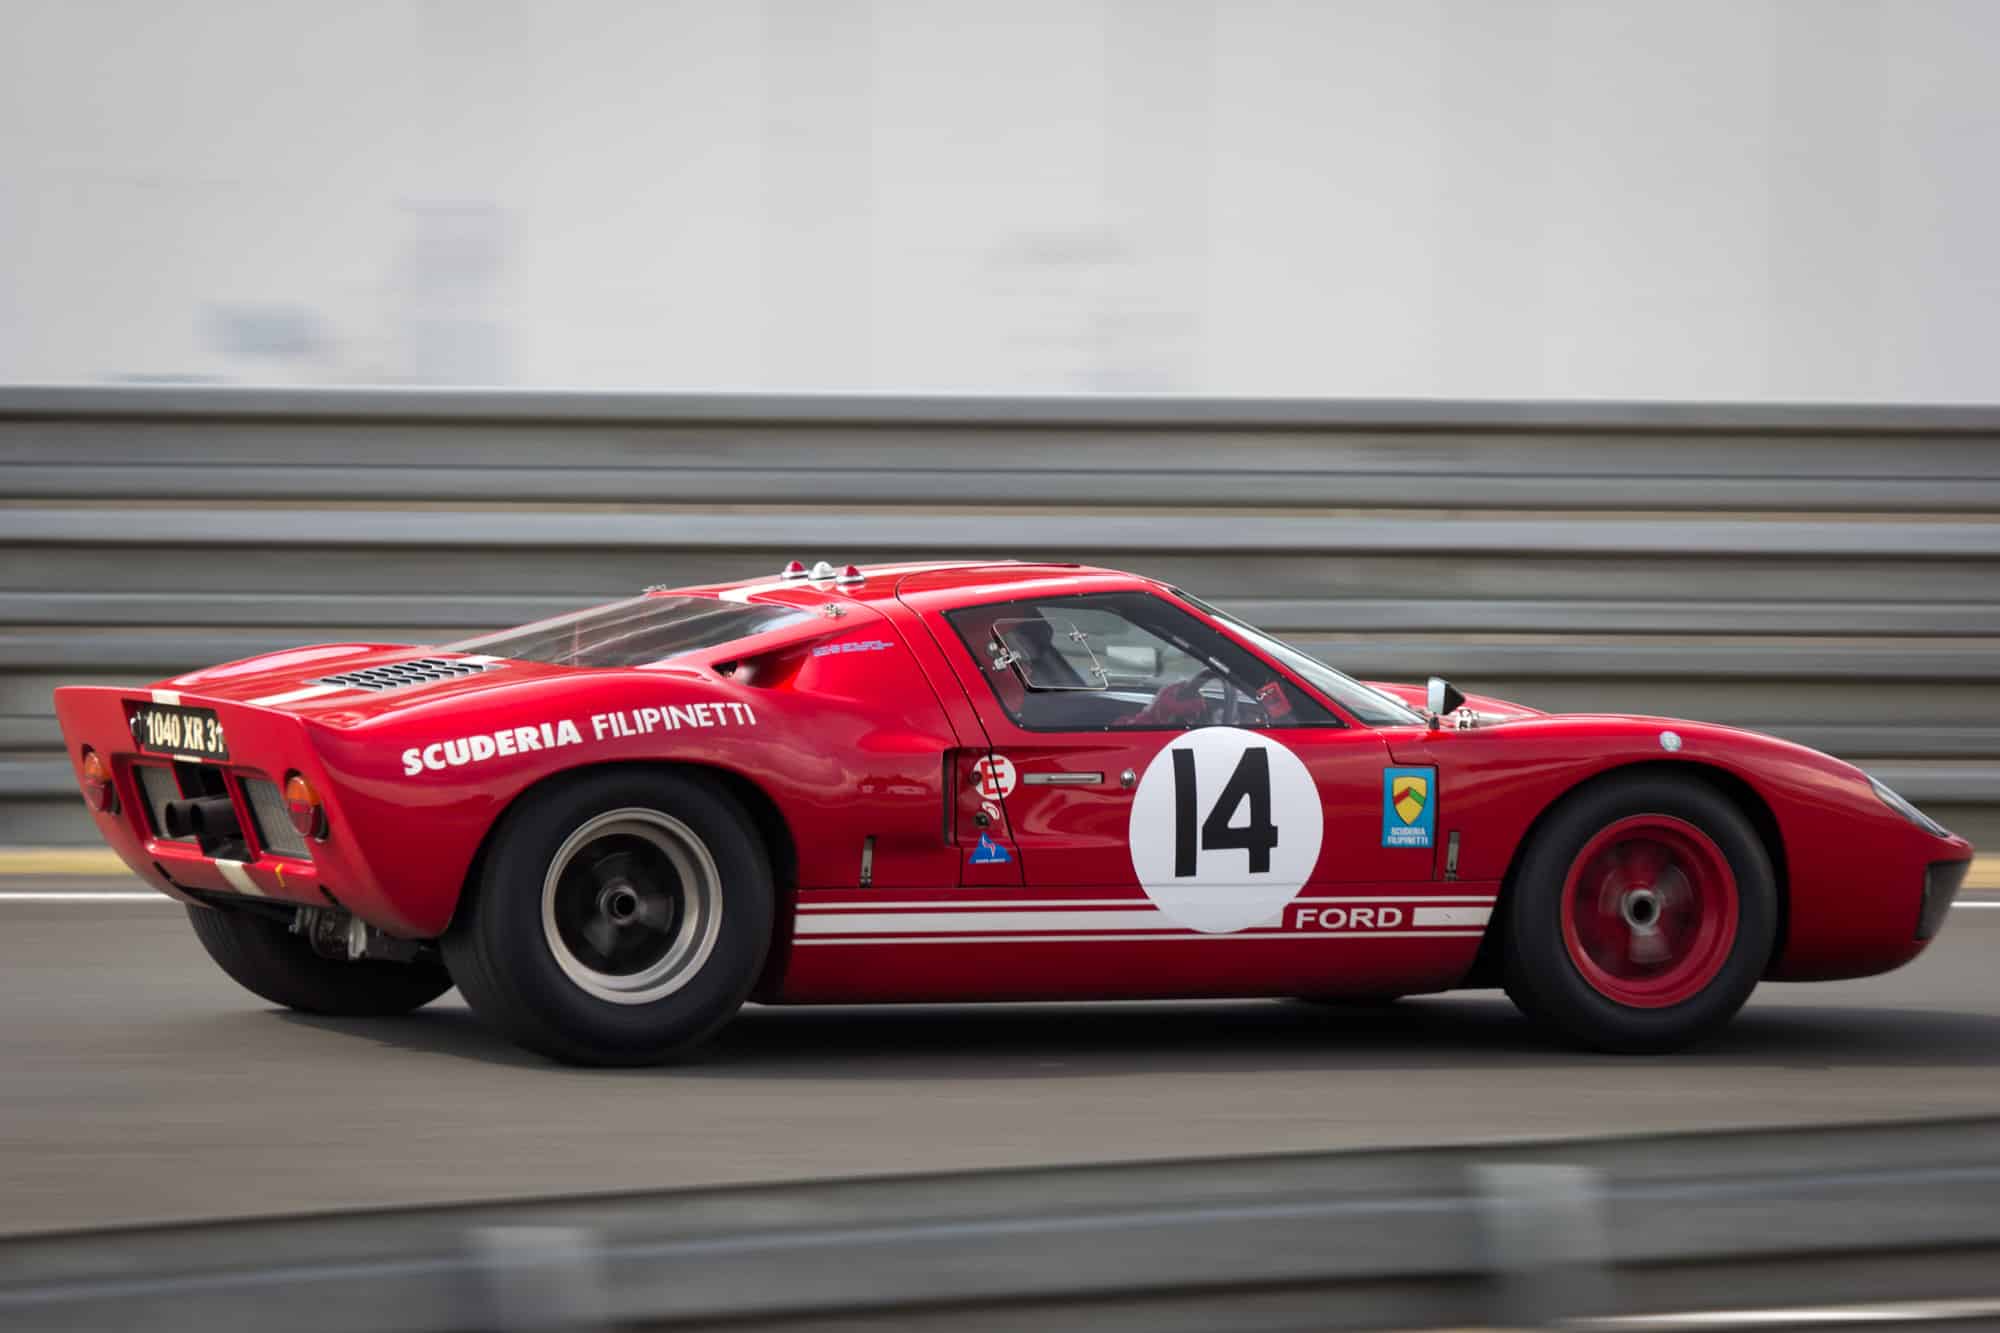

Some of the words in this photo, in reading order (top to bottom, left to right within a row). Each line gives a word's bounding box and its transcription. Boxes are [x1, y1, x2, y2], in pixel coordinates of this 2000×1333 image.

[146, 710, 181, 748] 1040
[183, 715, 206, 751] XR
[401, 719, 584, 776] SCUDERIA
[591, 702, 757, 740] FILIPINETTI
[979, 760, 1009, 795] E
[1172, 747, 1279, 877] 14
[1296, 907, 1403, 929] FORD
